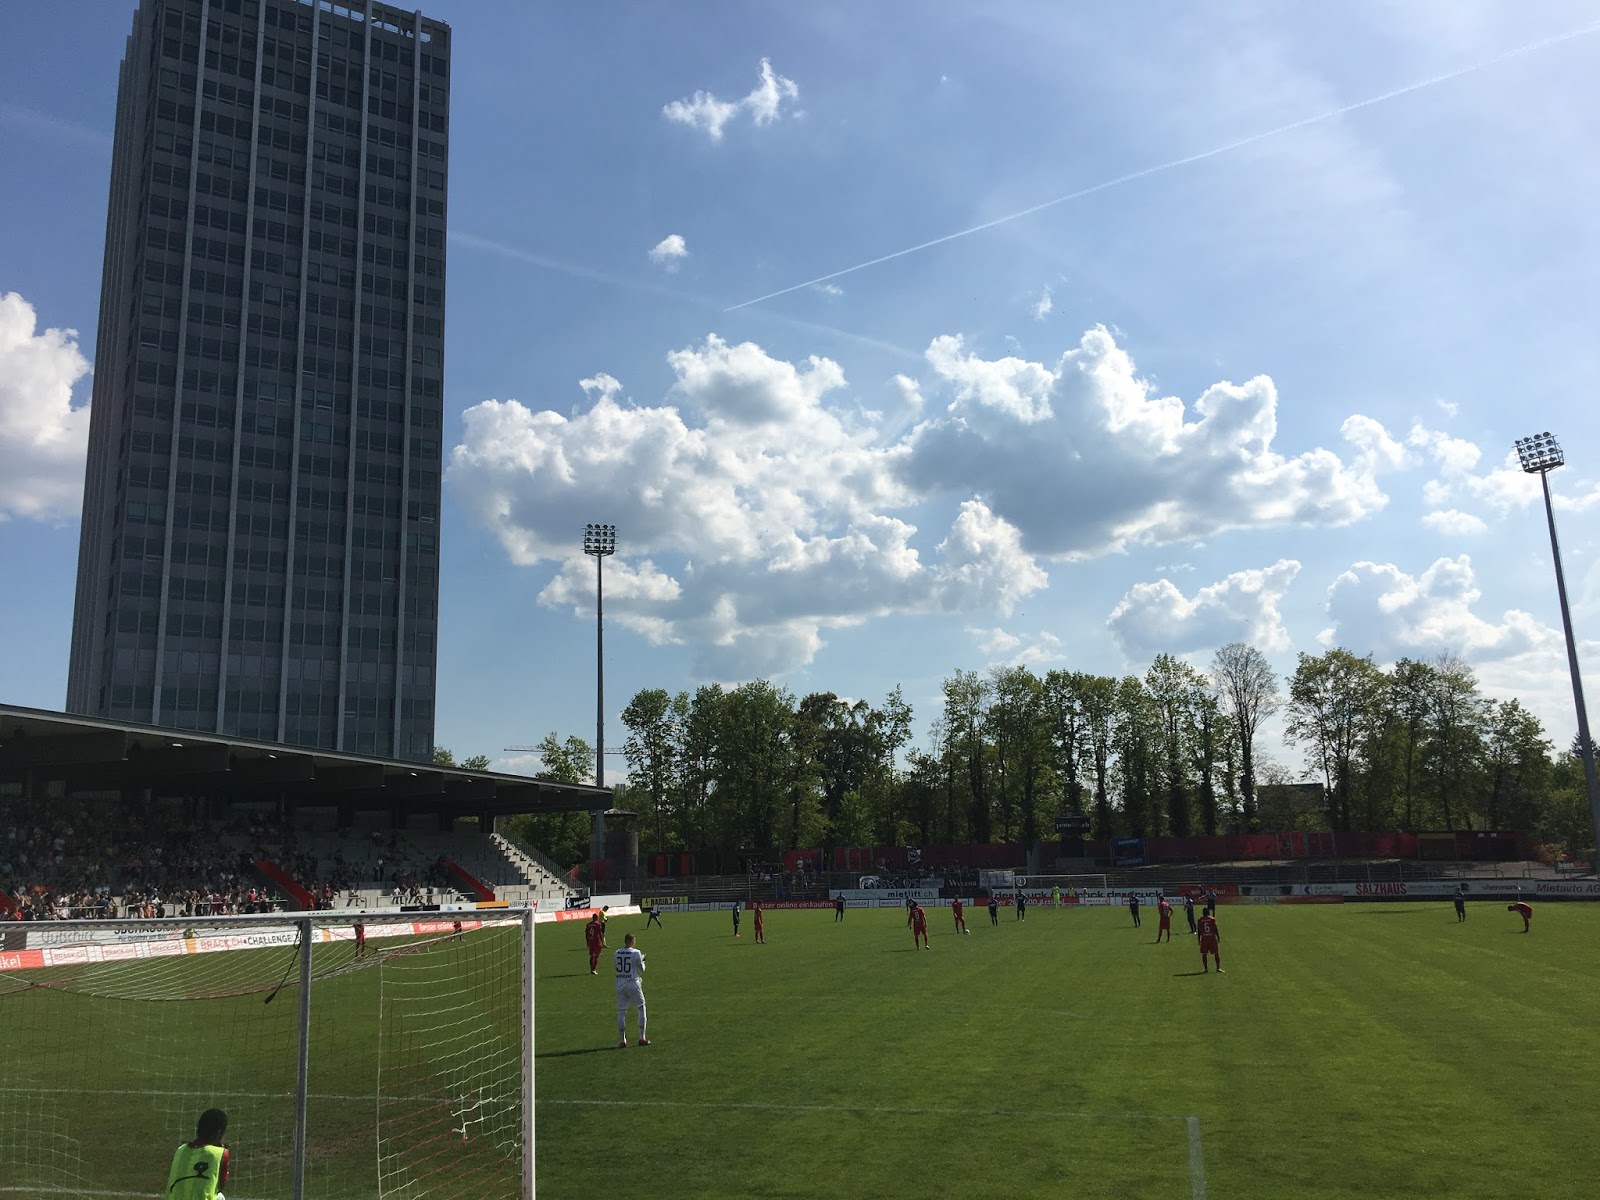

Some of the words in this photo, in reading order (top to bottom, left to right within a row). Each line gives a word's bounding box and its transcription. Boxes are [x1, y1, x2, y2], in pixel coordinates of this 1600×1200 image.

[1356, 883, 1407, 896] SALZHAUS
[799, 900, 834, 908] einkaufen
[1204, 922, 1211, 933] 6
[200, 938, 244, 951] BRACK.CH
[247, 933, 292, 946] CHALLENGE
